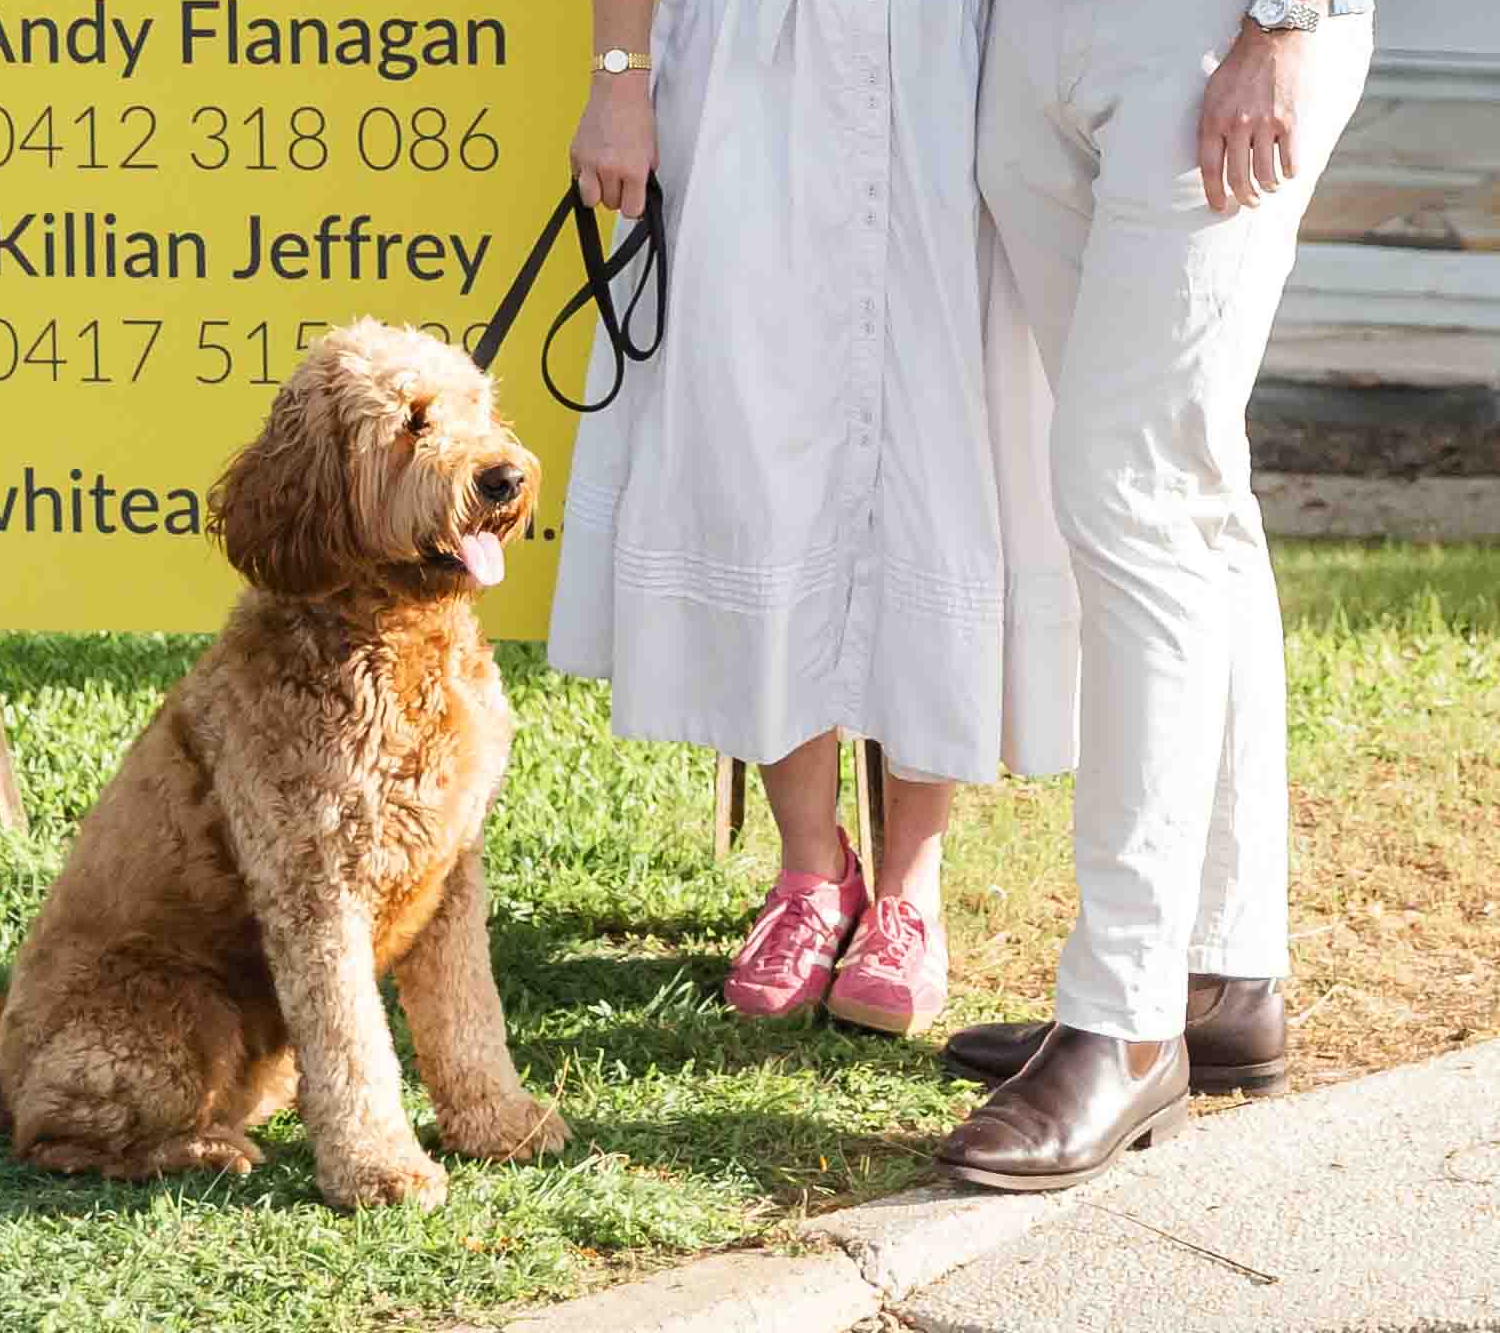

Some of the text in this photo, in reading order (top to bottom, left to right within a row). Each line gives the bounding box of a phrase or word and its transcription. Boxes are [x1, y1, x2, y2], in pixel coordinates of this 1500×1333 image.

[189, 105, 329, 172] 318
[357, 105, 500, 173] 086
[231, 213, 494, 296] Jeffrey
